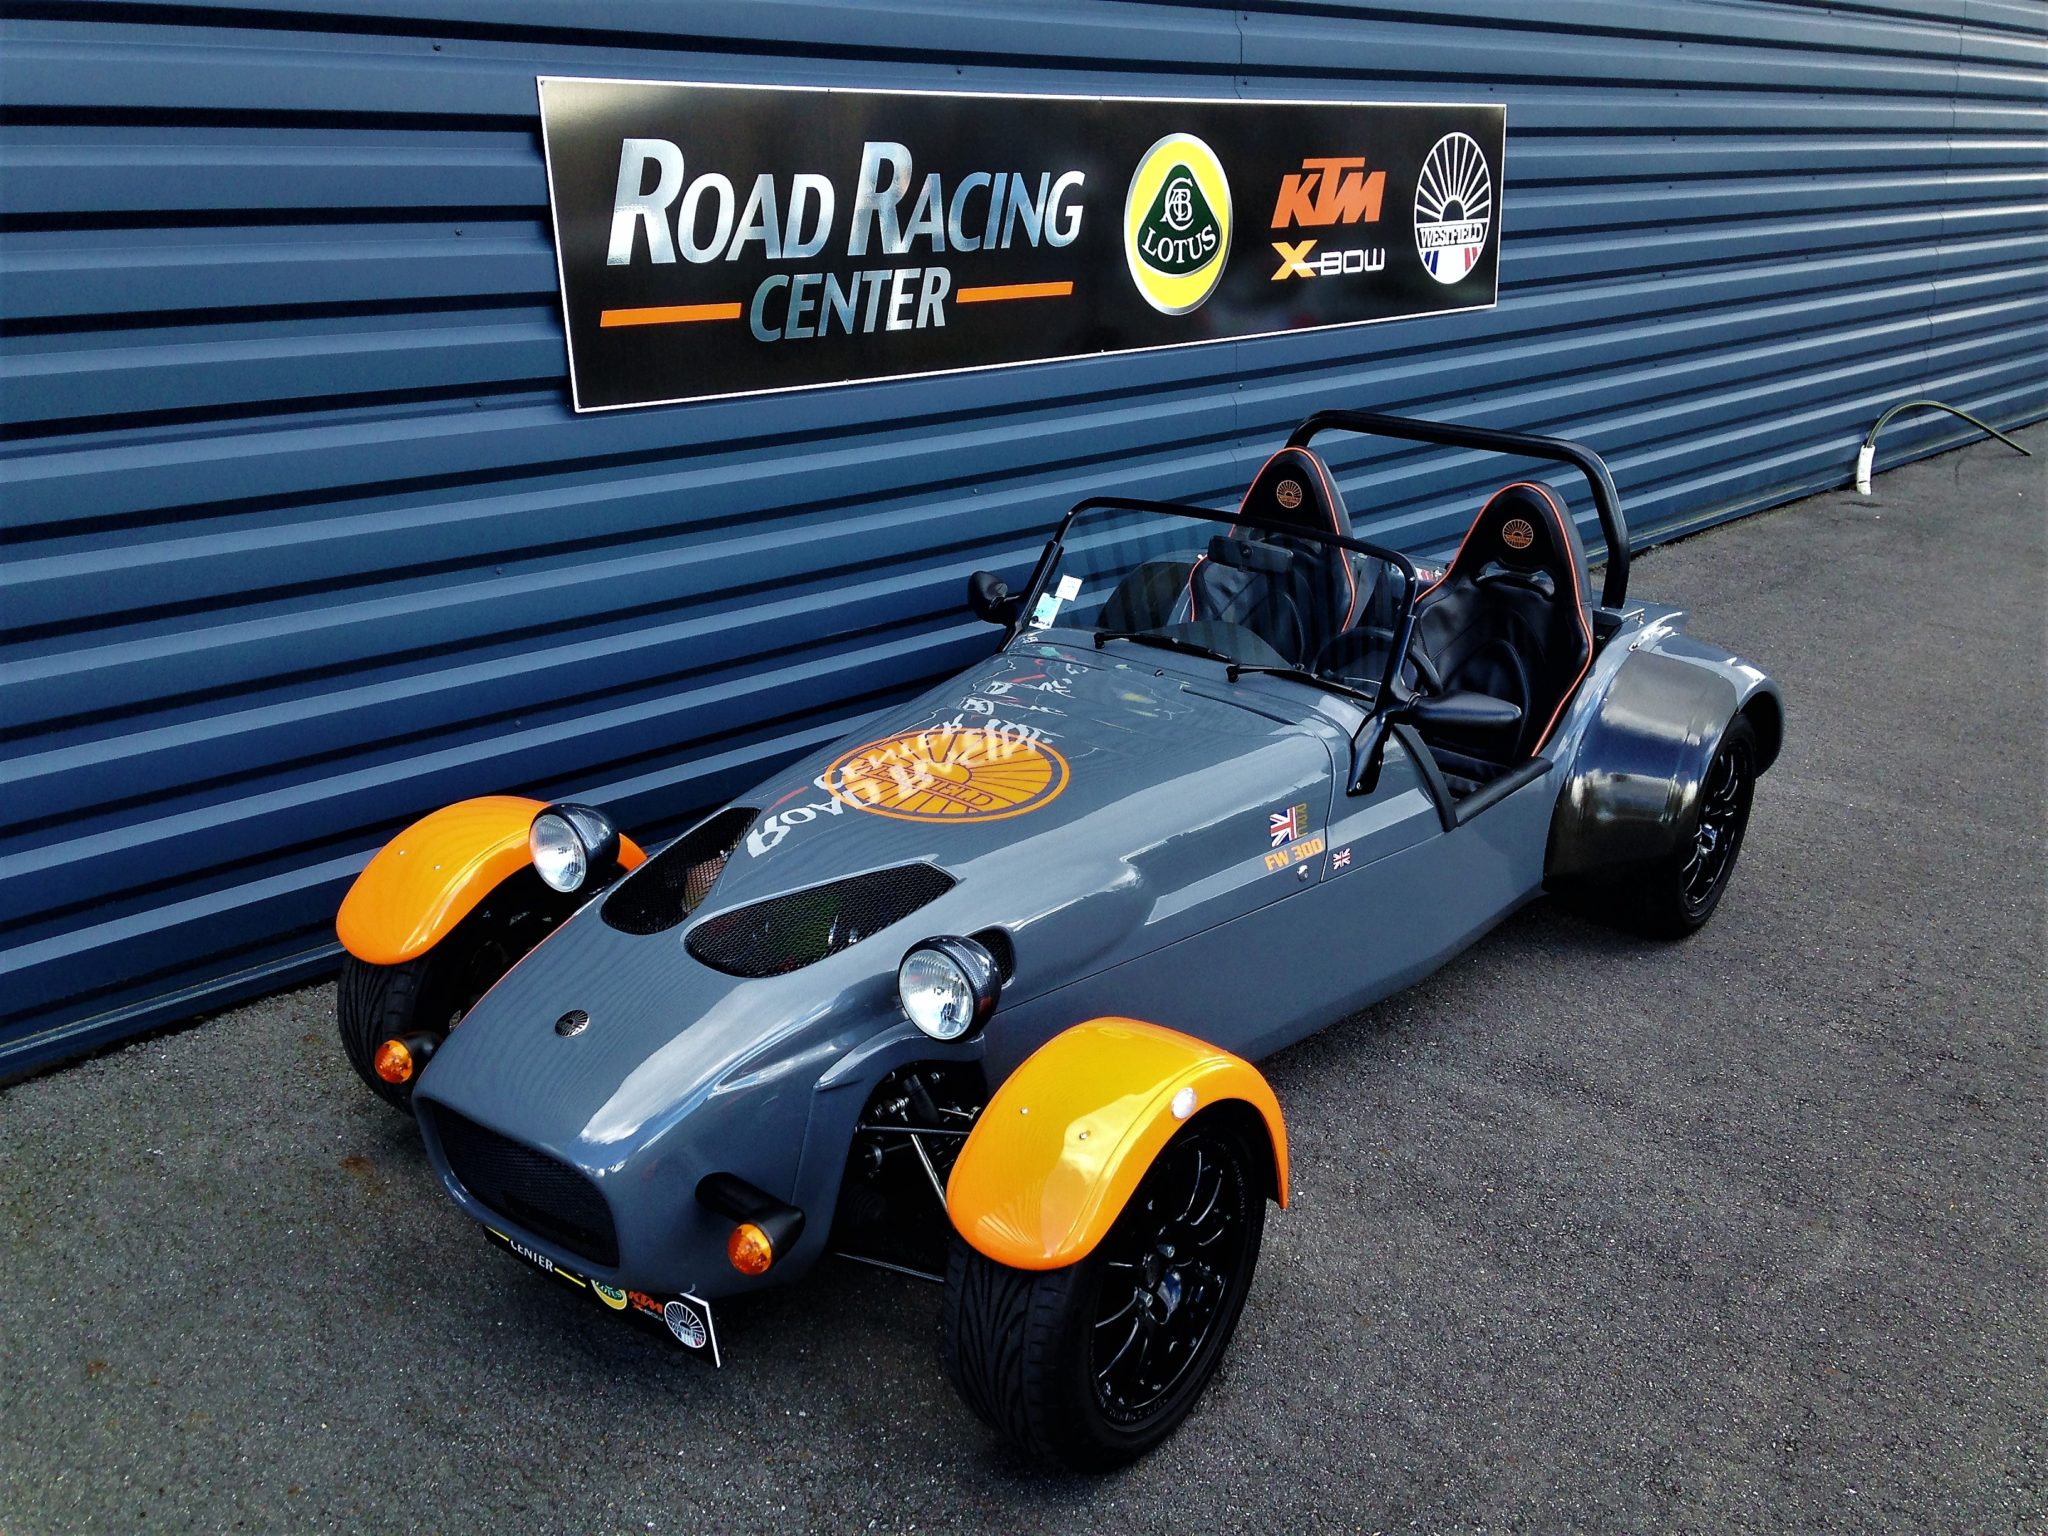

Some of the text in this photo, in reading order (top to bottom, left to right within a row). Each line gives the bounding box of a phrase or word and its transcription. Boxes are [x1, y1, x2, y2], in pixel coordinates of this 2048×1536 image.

[607, 138, 1086, 265] ROAD RACING
[1271, 157, 1386, 228] KTM
[1142, 224, 1217, 263] LOTUS
[1419, 223, 1484, 248] WESTFIELD
[1270, 240, 1385, 281] X-BOW
[749, 266, 951, 342] CENTER
[1265, 838, 1324, 871] FW 300
[628, 1291, 663, 1314] KTM
